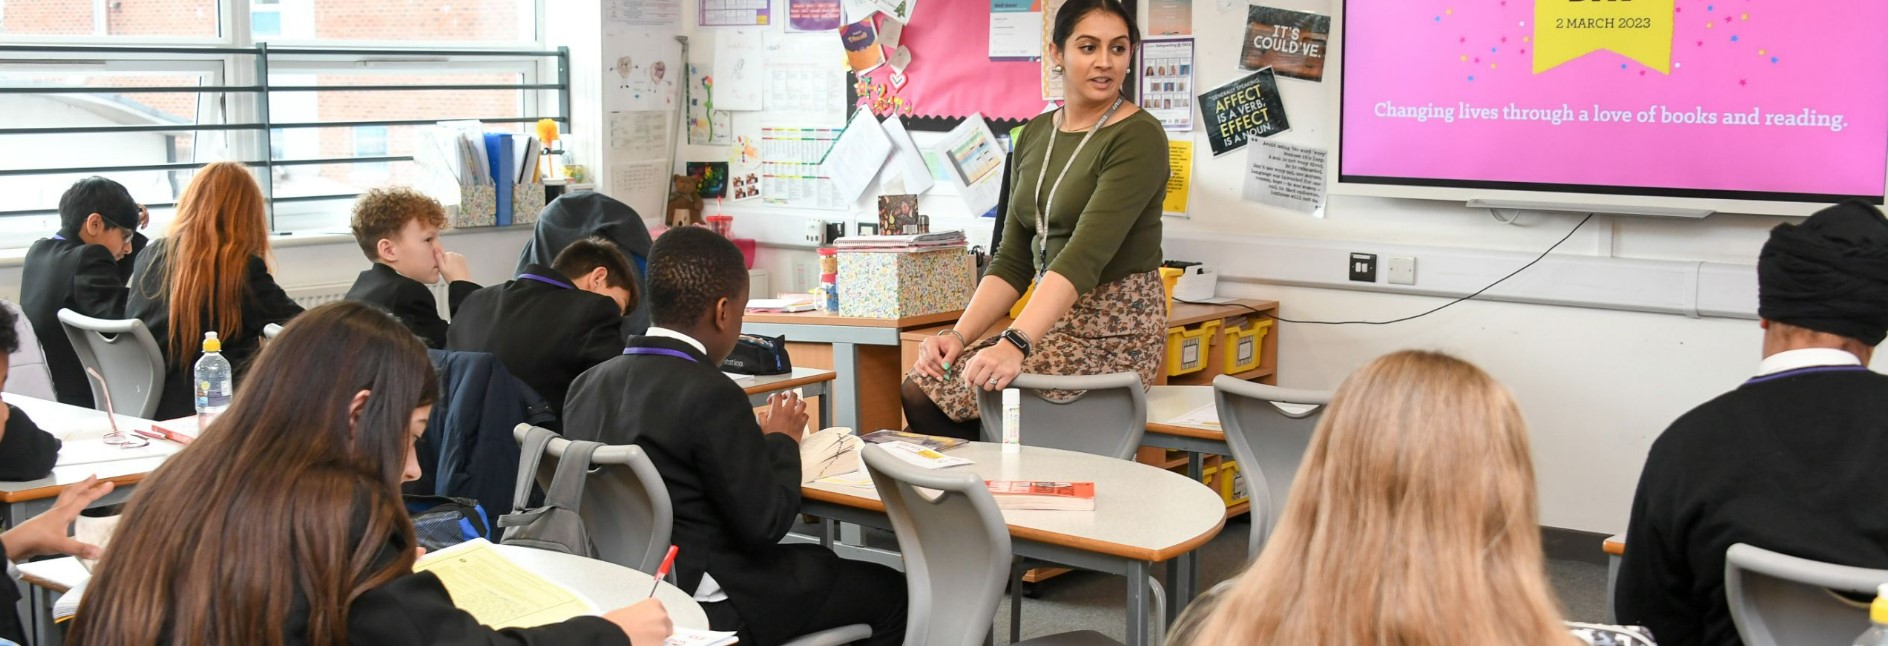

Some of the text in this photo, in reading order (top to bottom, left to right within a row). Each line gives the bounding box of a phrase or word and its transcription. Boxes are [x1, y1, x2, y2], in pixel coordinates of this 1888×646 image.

[1272, 25, 1300, 40] IT'S
[1556, 17, 1651, 29] 2 MARCH 2023
[1254, 36, 1321, 58] COULD'VE.
[1216, 84, 1261, 113] AFFECT
[1216, 98, 1266, 124] IS A VERB;
[1220, 108, 1269, 138] EFFECT
[1374, 101, 1848, 132] Changing lives through a love of books and reading.
[1224, 123, 1274, 146] IS A NOUN.
